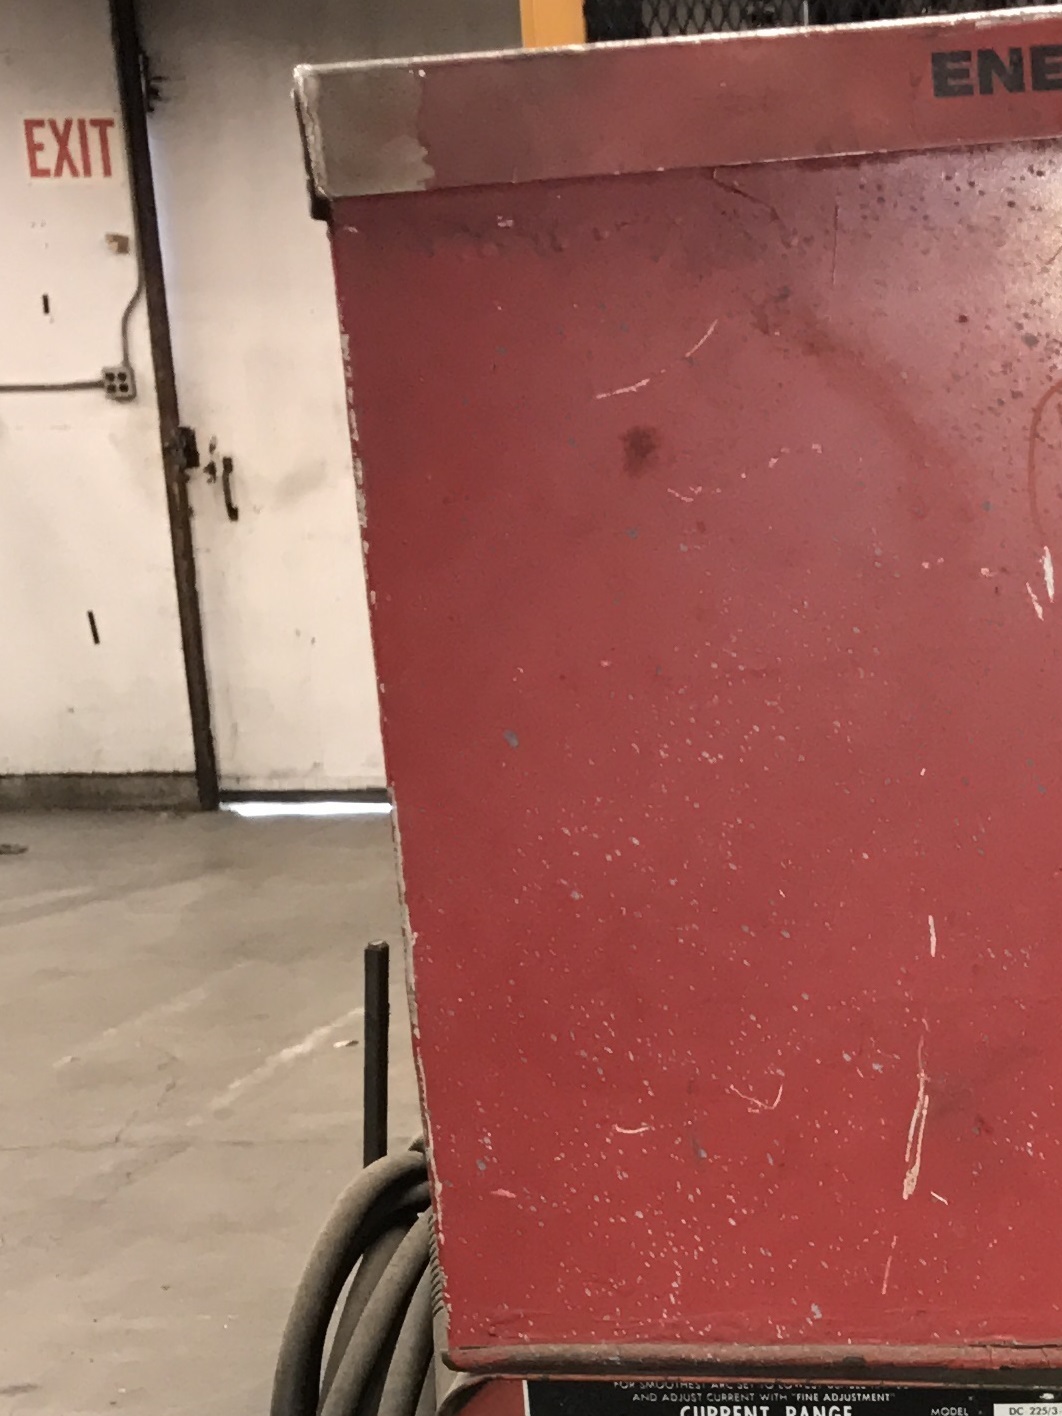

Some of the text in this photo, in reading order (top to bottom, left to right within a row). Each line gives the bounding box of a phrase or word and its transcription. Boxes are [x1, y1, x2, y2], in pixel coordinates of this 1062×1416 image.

[24, 118, 115, 178] EXIT
[632, 1393, 658, 1402] AND
[662, 1393, 702, 1402] ADJUST
[706, 1392, 755, 1402] CURRENT
[760, 1393, 788, 1401] WITH
[930, 1406, 969, 1416] MODEL
[1009, 1406, 1024, 1416] DC
